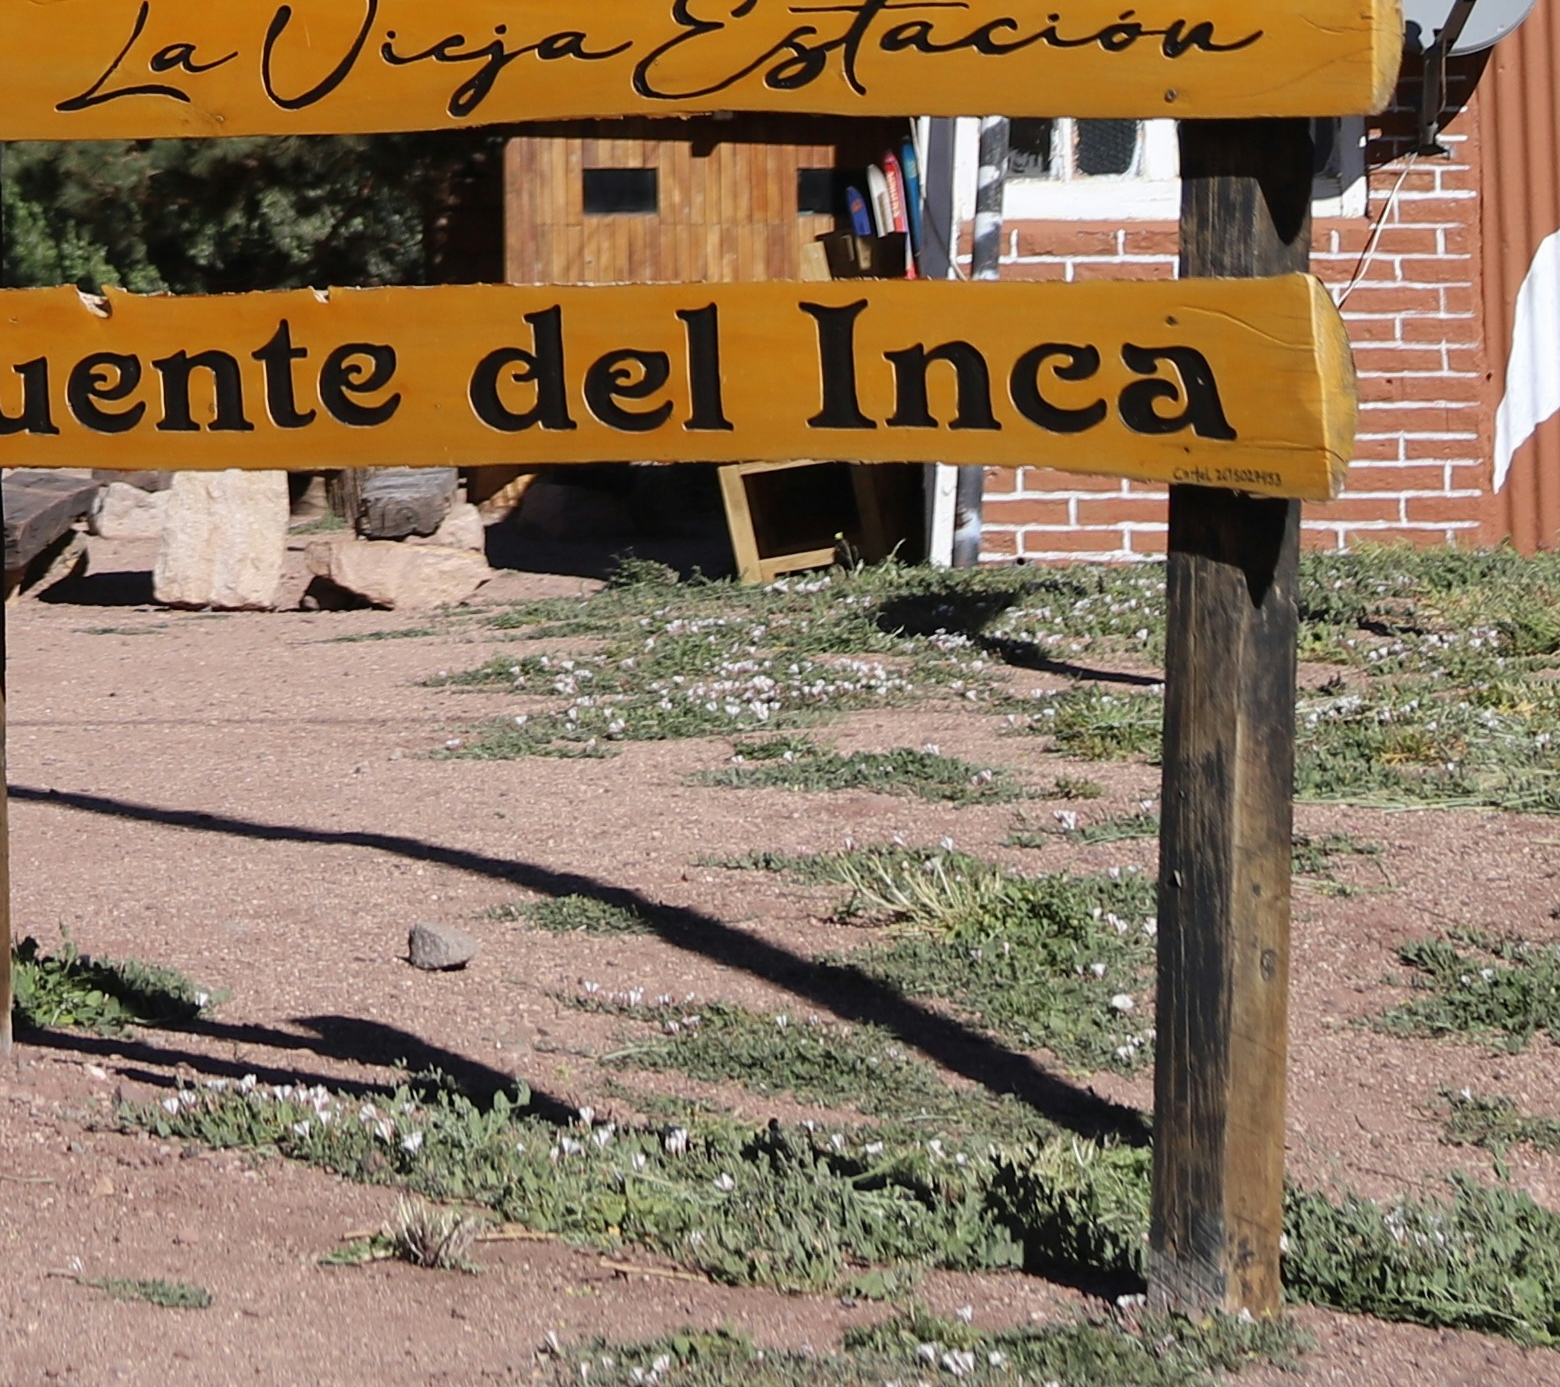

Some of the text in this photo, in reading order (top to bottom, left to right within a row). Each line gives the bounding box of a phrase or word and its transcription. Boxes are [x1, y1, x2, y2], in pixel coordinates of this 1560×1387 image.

[54, 0, 238, 112] La
[467, 302, 735, 432] del
[797, 299, 1238, 441] Inca
